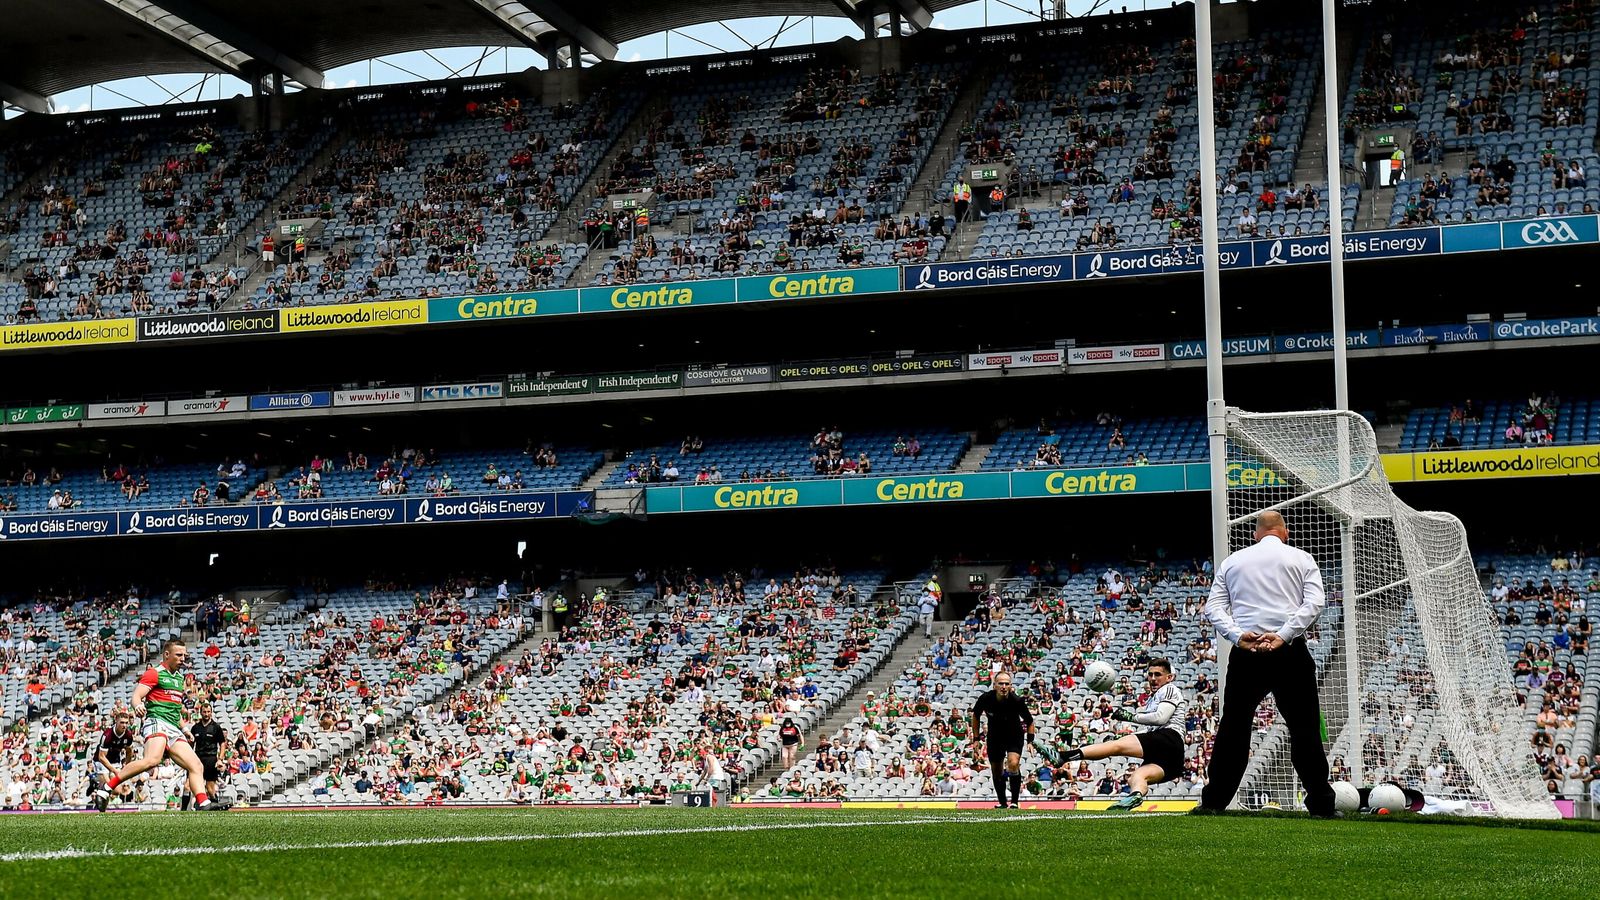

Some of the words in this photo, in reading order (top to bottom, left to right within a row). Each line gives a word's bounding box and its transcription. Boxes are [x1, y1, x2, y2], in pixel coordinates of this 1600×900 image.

[1290, 241, 1329, 258] Bord
[1341, 238, 1368, 254] áis
[1370, 237, 1427, 252] Energy
[1109, 255, 1147, 271] Bord
[1185, 251, 1240, 265] Engy
[938, 267, 974, 282] Bord
[976, 265, 1008, 279] Gáis
[1010, 264, 1062, 278] Energy
[768, 274, 855, 297] Centra
[610, 285, 693, 308] Centra
[457, 296, 538, 318] Centra
[1443, 330, 1478, 341] Elavon
[1497, 319, 1598, 337] @CrokePark
[1173, 344, 1204, 358] GAA
[1221, 339, 1270, 354] USEUM
[1284, 333, 1369, 349] @Crokeark
[973, 357, 986, 365] sky
[987, 356, 1011, 365] sports
[1019, 354, 1032, 363] sky
[1033, 353, 1058, 362] sports
[1072, 351, 1086, 361] sky
[1087, 350, 1112, 360] sports
[1119, 349, 1132, 359] sky
[1133, 348, 1160, 358] sports
[686, 369, 728, 379] COSGROVE
[730, 367, 768, 377] GAYNARD
[780, 368, 801, 377] OPEL
[809, 366, 830, 375] OPEL
[839, 365, 860, 374] OPEL
[872, 363, 893, 372] OPEL
[901, 361, 923, 371] OPEL
[932, 359, 954, 368] OPEL
[509, 382, 529, 392] Irish
[530, 379, 581, 392] Independent
[598, 377, 618, 388] Irish
[619, 374, 672, 388] Independent
[710, 376, 744, 384] SOLICITORS
[268, 396, 300, 407] Allianz
[349, 391, 400, 402] www.hyl.ie
[103, 404, 137, 414] aramark
[183, 401, 217, 411] aramark
[876, 478, 964, 501] Centra
[1045, 470, 1137, 494] Centra
[714, 485, 799, 508] Centra
[288, 508, 319, 522] Bord
[321, 507, 349, 521] Gáis
[350, 507, 395, 520] Energy
[435, 502, 467, 516] Bord
[469, 500, 498, 514] Gáis
[499, 500, 546, 514] Energy
[9, 520, 38, 534] Bord
[40, 519, 65, 533] Gáis
[66, 519, 109, 533] Energy
[145, 514, 176, 528] Bord
[178, 512, 204, 526] Gáis
[205, 513, 249, 526] Energy
[694, 795, 702, 807] 9
